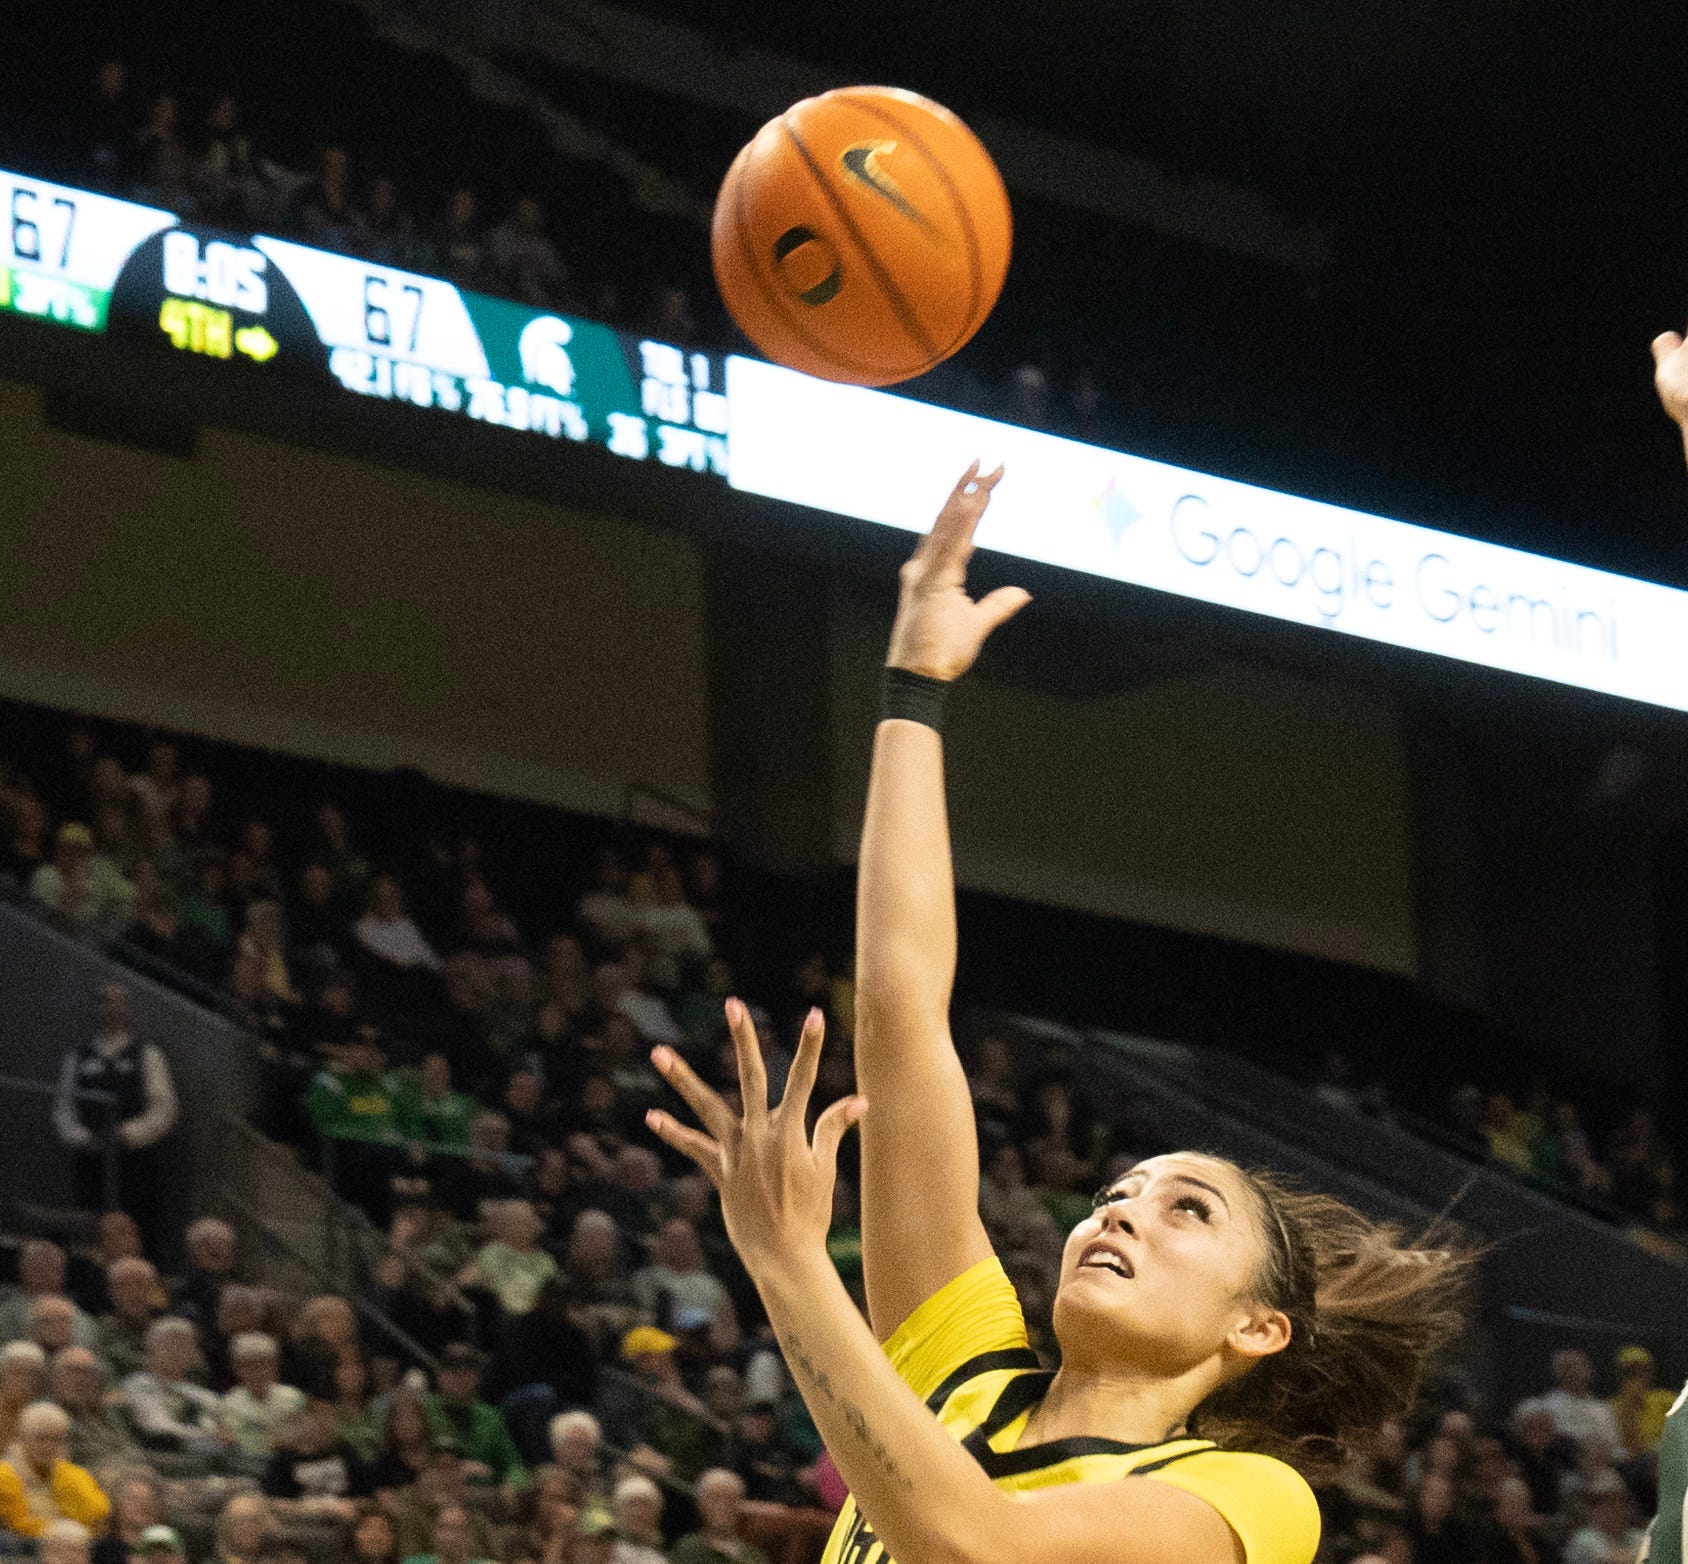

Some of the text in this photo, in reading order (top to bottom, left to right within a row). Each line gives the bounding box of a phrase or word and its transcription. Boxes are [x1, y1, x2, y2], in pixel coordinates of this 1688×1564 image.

[12, 186, 77, 268] 67
[364, 274, 424, 351] 67
[1171, 493, 1620, 661] Google Gemini
